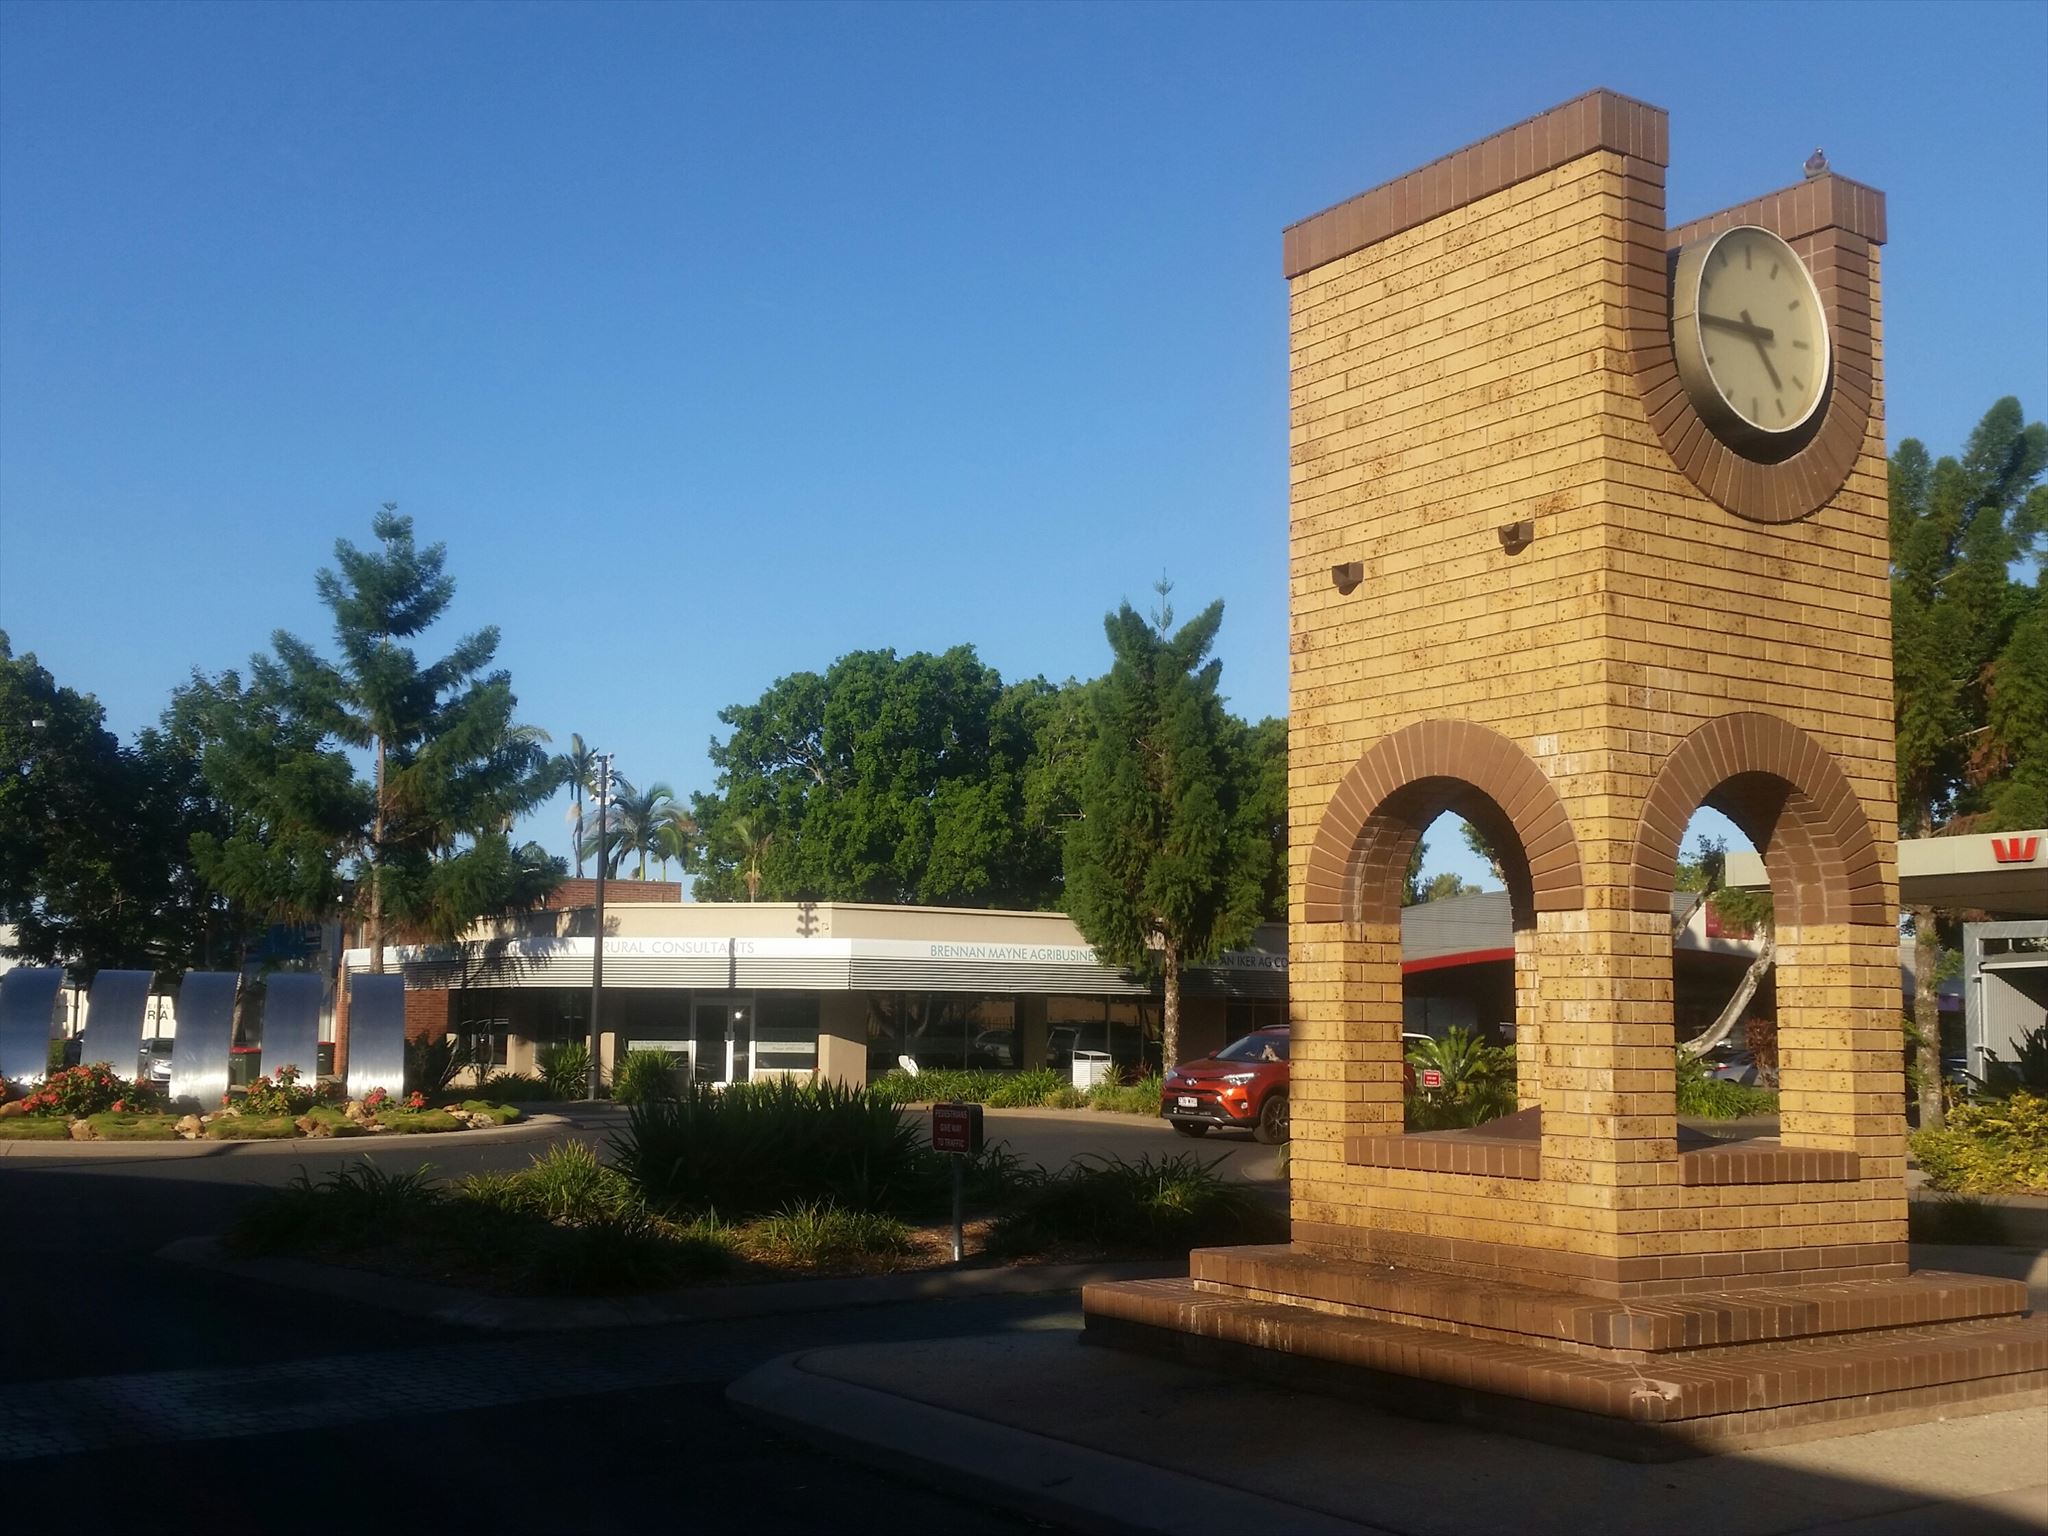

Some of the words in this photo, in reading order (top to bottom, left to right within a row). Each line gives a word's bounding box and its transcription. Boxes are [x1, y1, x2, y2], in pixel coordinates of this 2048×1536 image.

[603, 942, 645, 953] RURAL
[652, 941, 754, 954] CONSULTANTS
[930, 945, 985, 958] BRENNAN
[988, 947, 1027, 959] MAYNE
[1030, 948, 1099, 962] AGRIBUSINE
